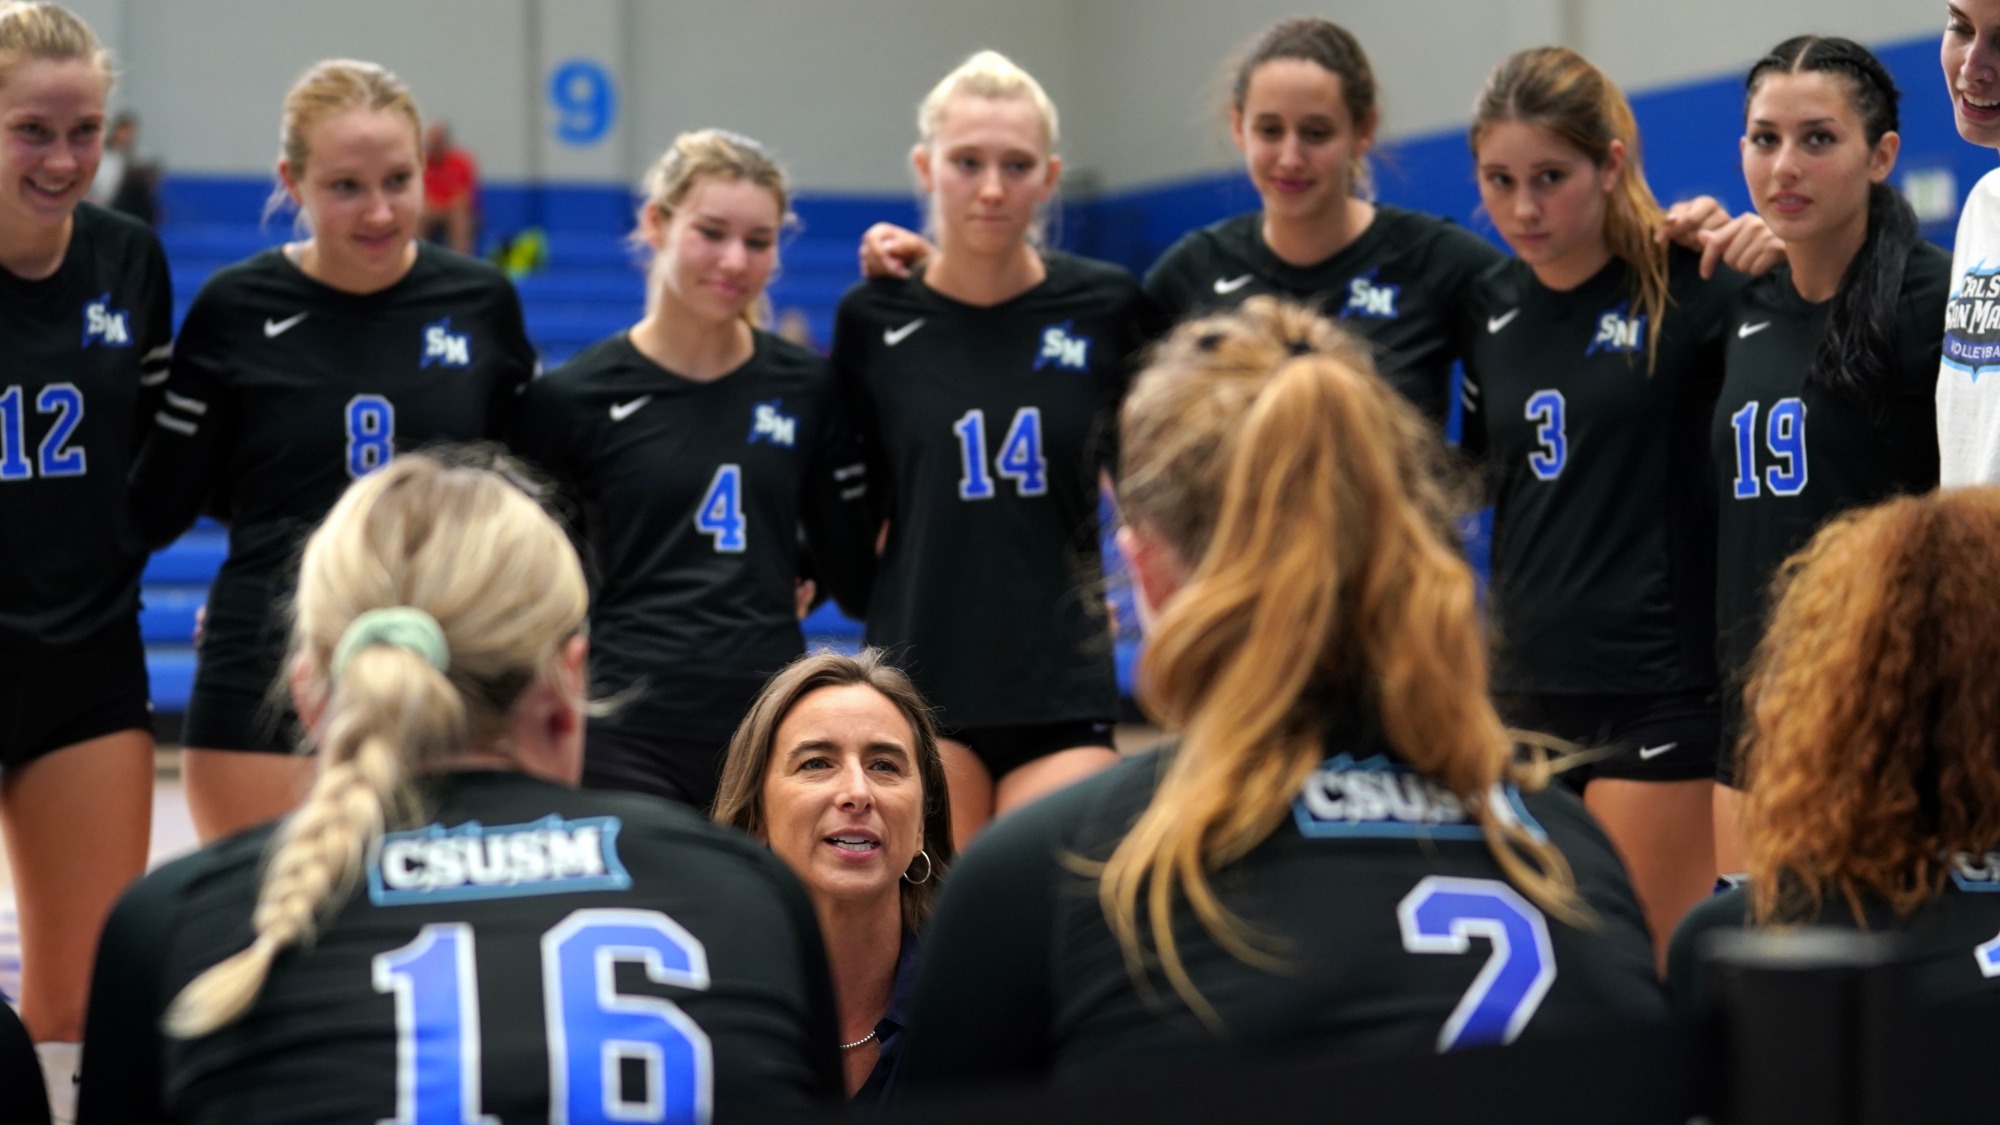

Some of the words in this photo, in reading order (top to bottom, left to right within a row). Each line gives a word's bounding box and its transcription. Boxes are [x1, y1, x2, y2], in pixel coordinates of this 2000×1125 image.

[547, 58, 618, 147] 9
[87, 303, 128, 343] SM
[1348, 278, 1392, 315] SM
[1596, 313, 1640, 347] SM
[425, 327, 469, 364] SM
[1042, 331, 1086, 367] SM
[0, 382, 87, 480] 12
[345, 394, 395, 479] 8
[755, 404, 796, 445] SM
[953, 406, 1048, 500] 14
[1525, 388, 1567, 481] 3
[1731, 398, 1808, 498] 19
[694, 463, 746, 552] 4
[383, 827, 604, 891] CSUSM
[1397, 876, 1557, 1054] 2
[372, 908, 713, 1125] 16
